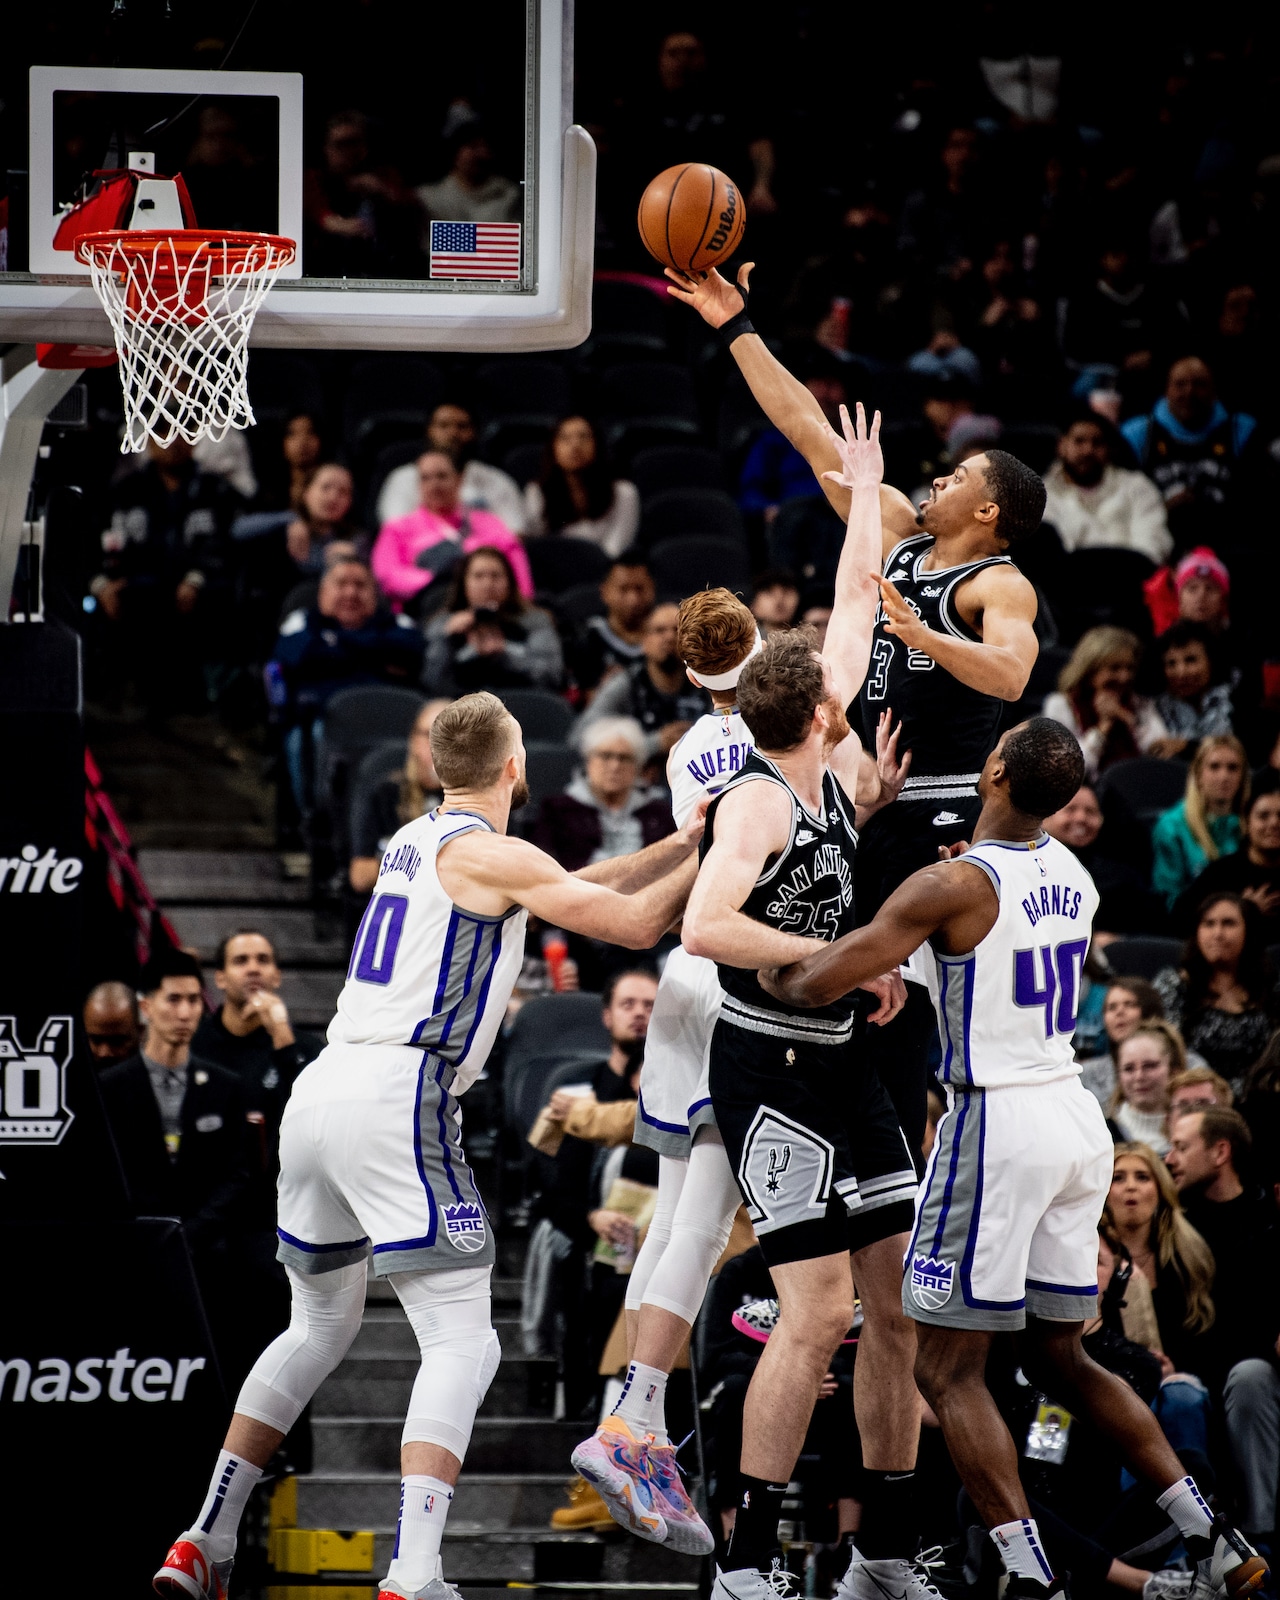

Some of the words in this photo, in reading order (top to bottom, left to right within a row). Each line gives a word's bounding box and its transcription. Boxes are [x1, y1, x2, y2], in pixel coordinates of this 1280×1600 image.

[705, 183, 736, 251] Wilson
[898, 551, 914, 565] 6
[867, 639, 896, 701] 3
[687, 742, 753, 786] HUERT
[380, 844, 422, 883] SABONIS
[766, 864, 812, 918] SAN
[1021, 884, 1082, 928] BARNES
[777, 894, 842, 943] 25
[1012, 936, 1089, 1041] 40
[447, 1219, 484, 1233] SAC
[912, 1271, 951, 1292] SAC
